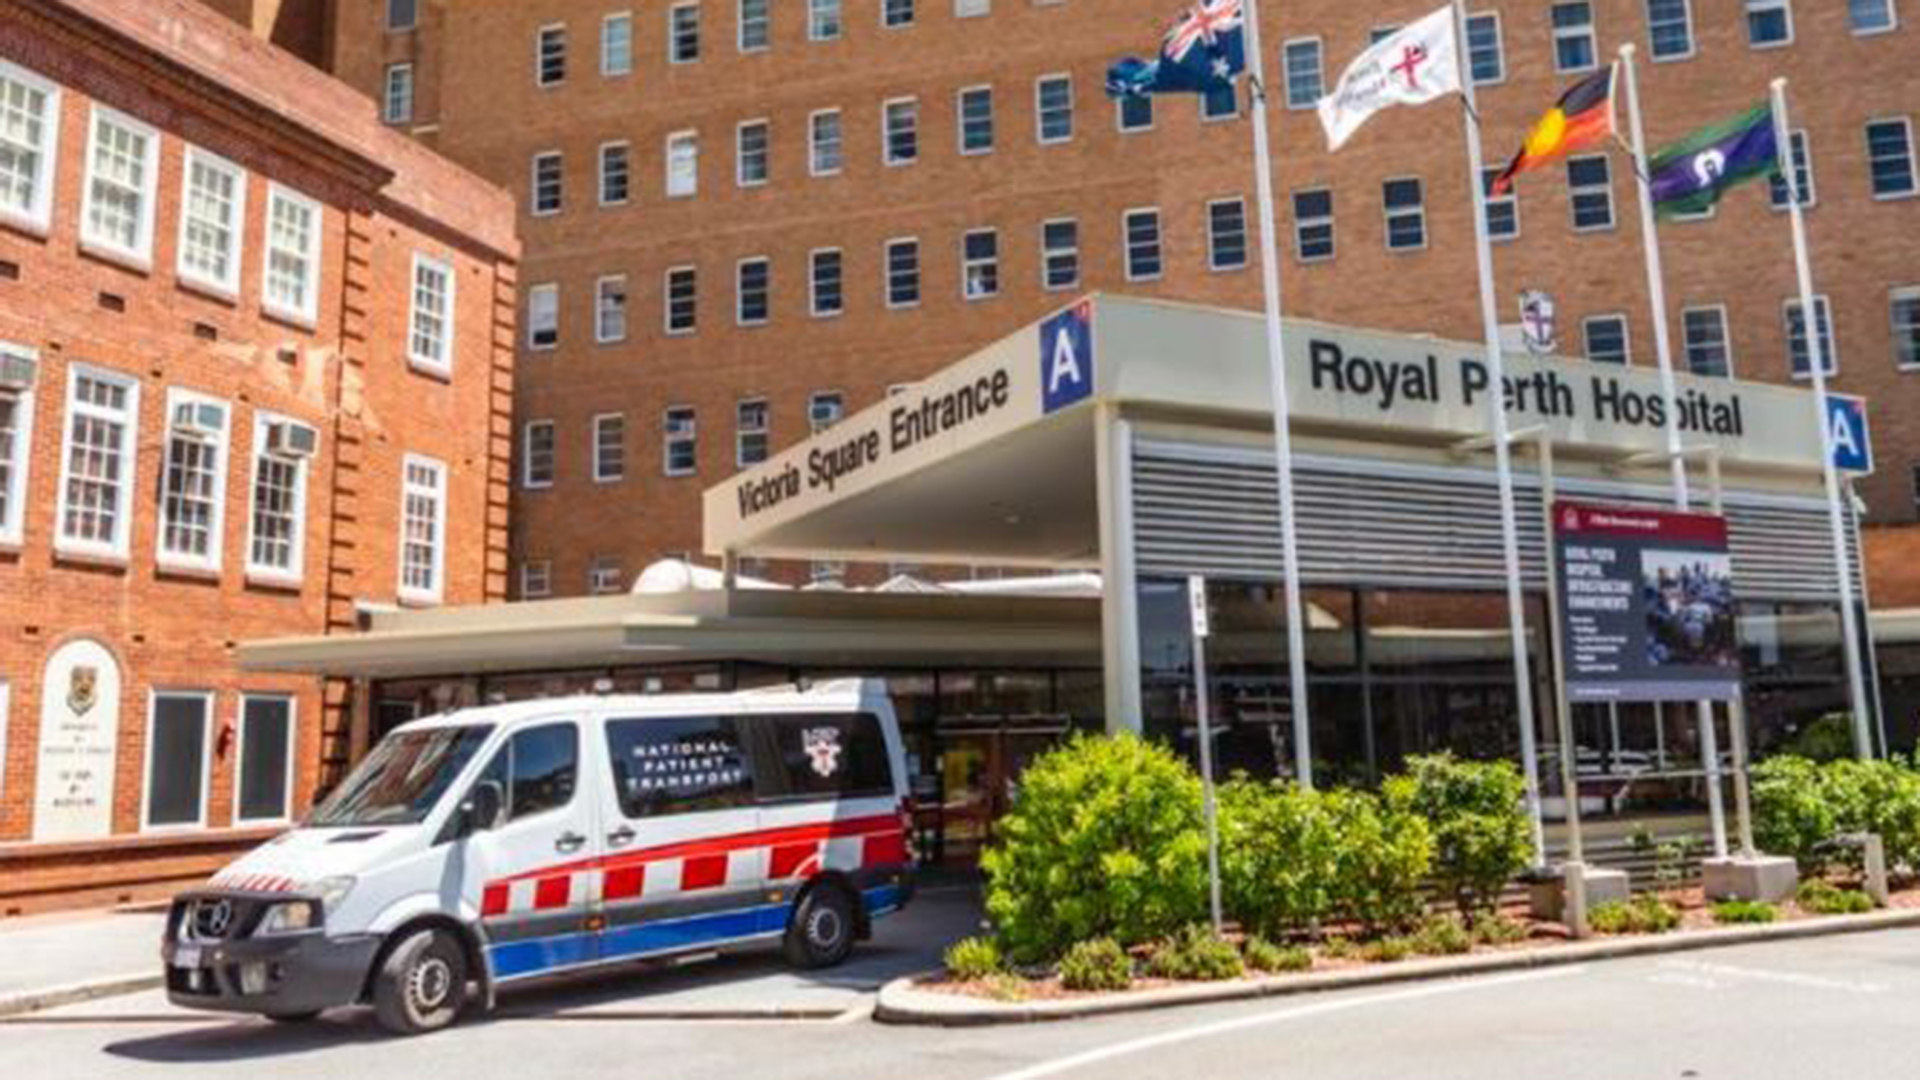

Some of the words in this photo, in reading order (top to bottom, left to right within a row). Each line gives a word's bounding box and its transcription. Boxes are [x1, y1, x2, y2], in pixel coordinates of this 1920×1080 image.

[1048, 327, 1081, 393] A
[1308, 338, 1440, 410] Royal
[736, 462, 801, 518] Victoria
[807, 429, 880, 492] Square
[890, 368, 1009, 452] Entrance
[1828, 408, 1861, 458] A
[633, 741, 731, 756] NATIONAL
[644, 756, 724, 772] PATIENT
[627, 770, 742, 789] TRANSPORT
